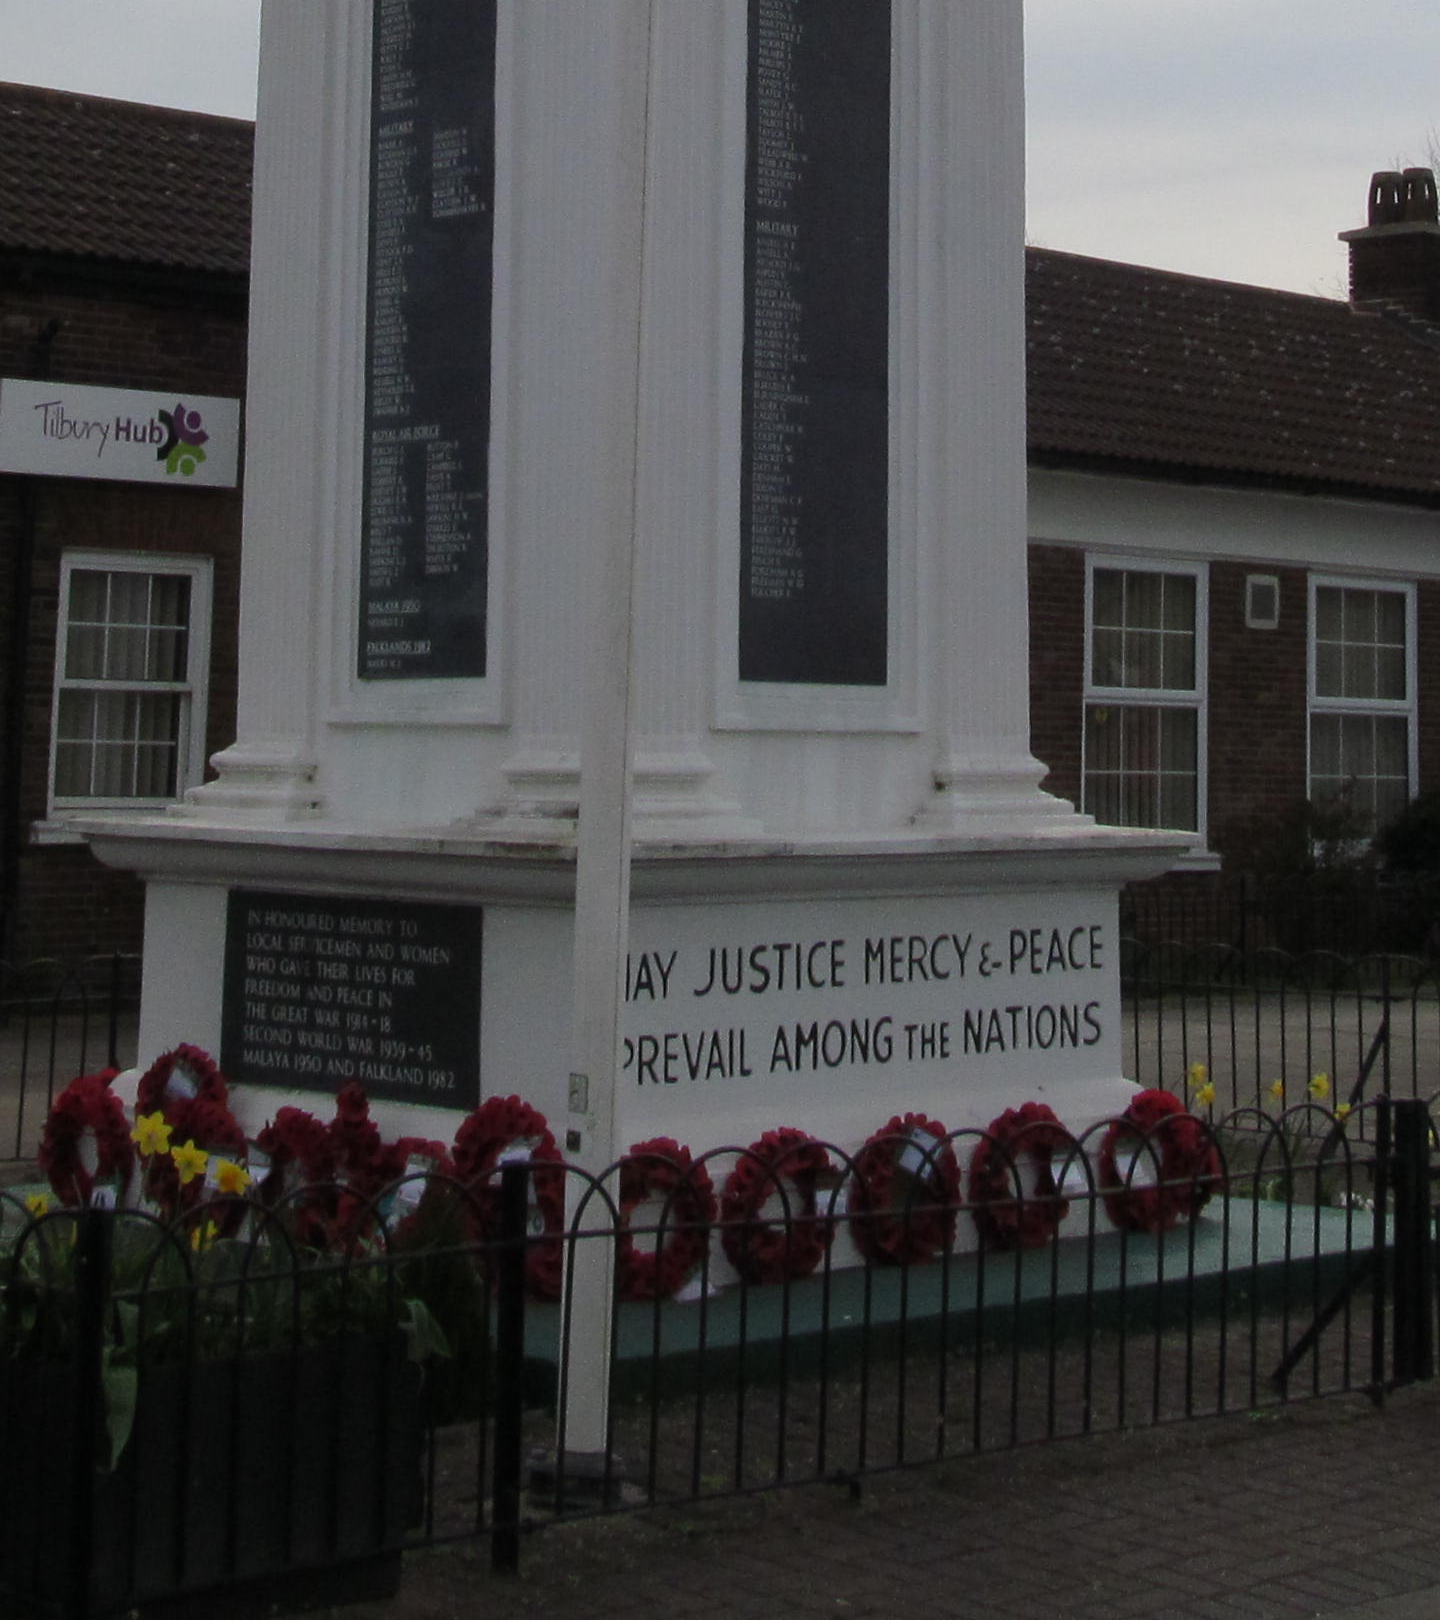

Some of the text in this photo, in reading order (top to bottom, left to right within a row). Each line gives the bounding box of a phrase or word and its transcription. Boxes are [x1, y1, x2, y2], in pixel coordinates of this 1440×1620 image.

[756, 221, 799, 236] MILITARY
[34, 400, 164, 459] Tilbury Hub
[248, 910, 417, 938] IN HONOURED MEMORY TO
[247, 932, 283, 952] LOCAL
[367, 942, 394, 960] AND
[400, 945, 451, 964] WOMEN
[625, 950, 678, 1002] AY
[694, 939, 845, 997] JUSTICE
[864, 933, 972, 985] MERCY
[1010, 925, 1104, 975] PEACE
[246, 955, 276, 973] WHO
[317, 961, 349, 980] THEIR
[355, 965, 387, 984] LIVES
[392, 967, 416, 986] FOR
[245, 977, 392, 1008] FREEDOM AND PEACE IN
[246, 1001, 266, 1020] THE
[272, 1004, 308, 1023] GREAT
[314, 1008, 340, 1027] WAR
[243, 1024, 292, 1045] SECOND
[297, 1030, 342, 1051] WORLD
[347, 1035, 373, 1055] WAR
[770, 1015, 893, 1073] AMONG
[904, 1021, 950, 1061] THE
[963, 1001, 1102, 1055] NATIONS
[243, 1049, 456, 1090] MALAYA 1950 AND FALKLAND 1982
